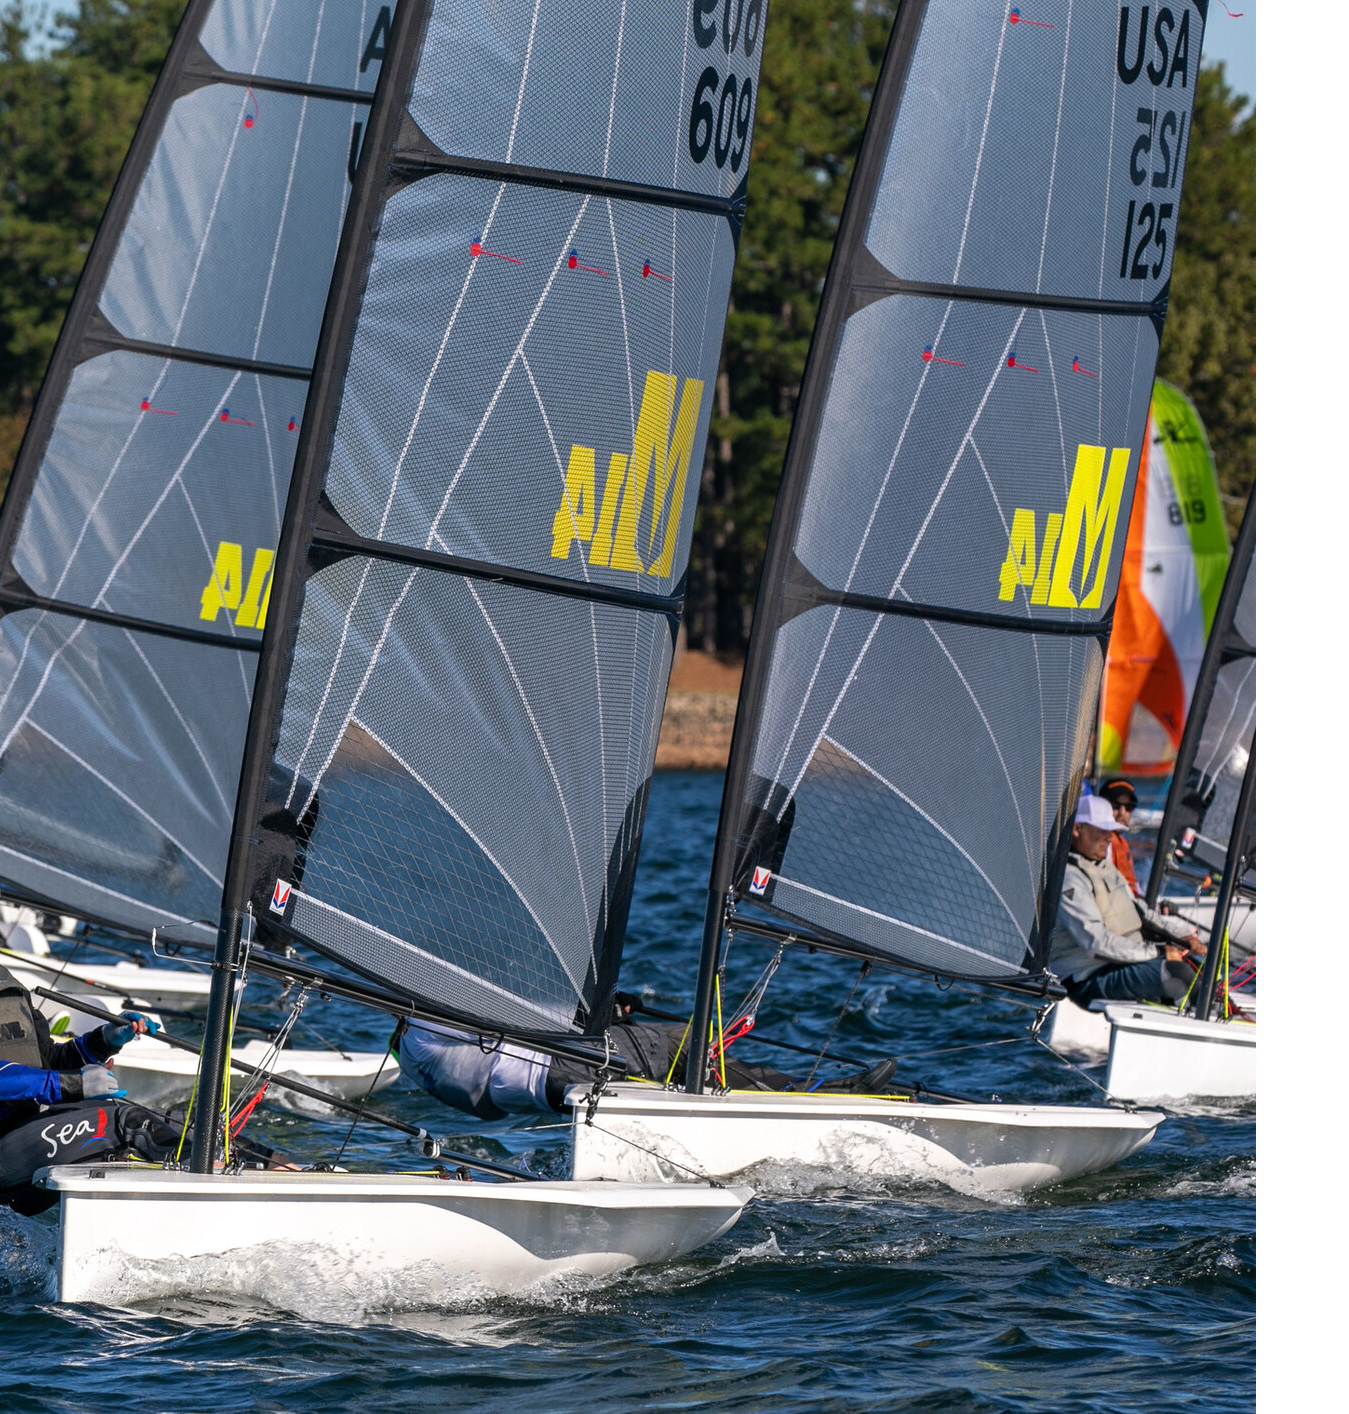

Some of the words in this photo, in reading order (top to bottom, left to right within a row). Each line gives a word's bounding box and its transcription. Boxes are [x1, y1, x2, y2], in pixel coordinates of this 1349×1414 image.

[1117, 6, 1190, 88] USA
[689, 66, 752, 173] 609
[1120, 200, 1173, 280] 125
[1167, 500, 1206, 525] 819
[40, 1119, 96, 1158] Sea
